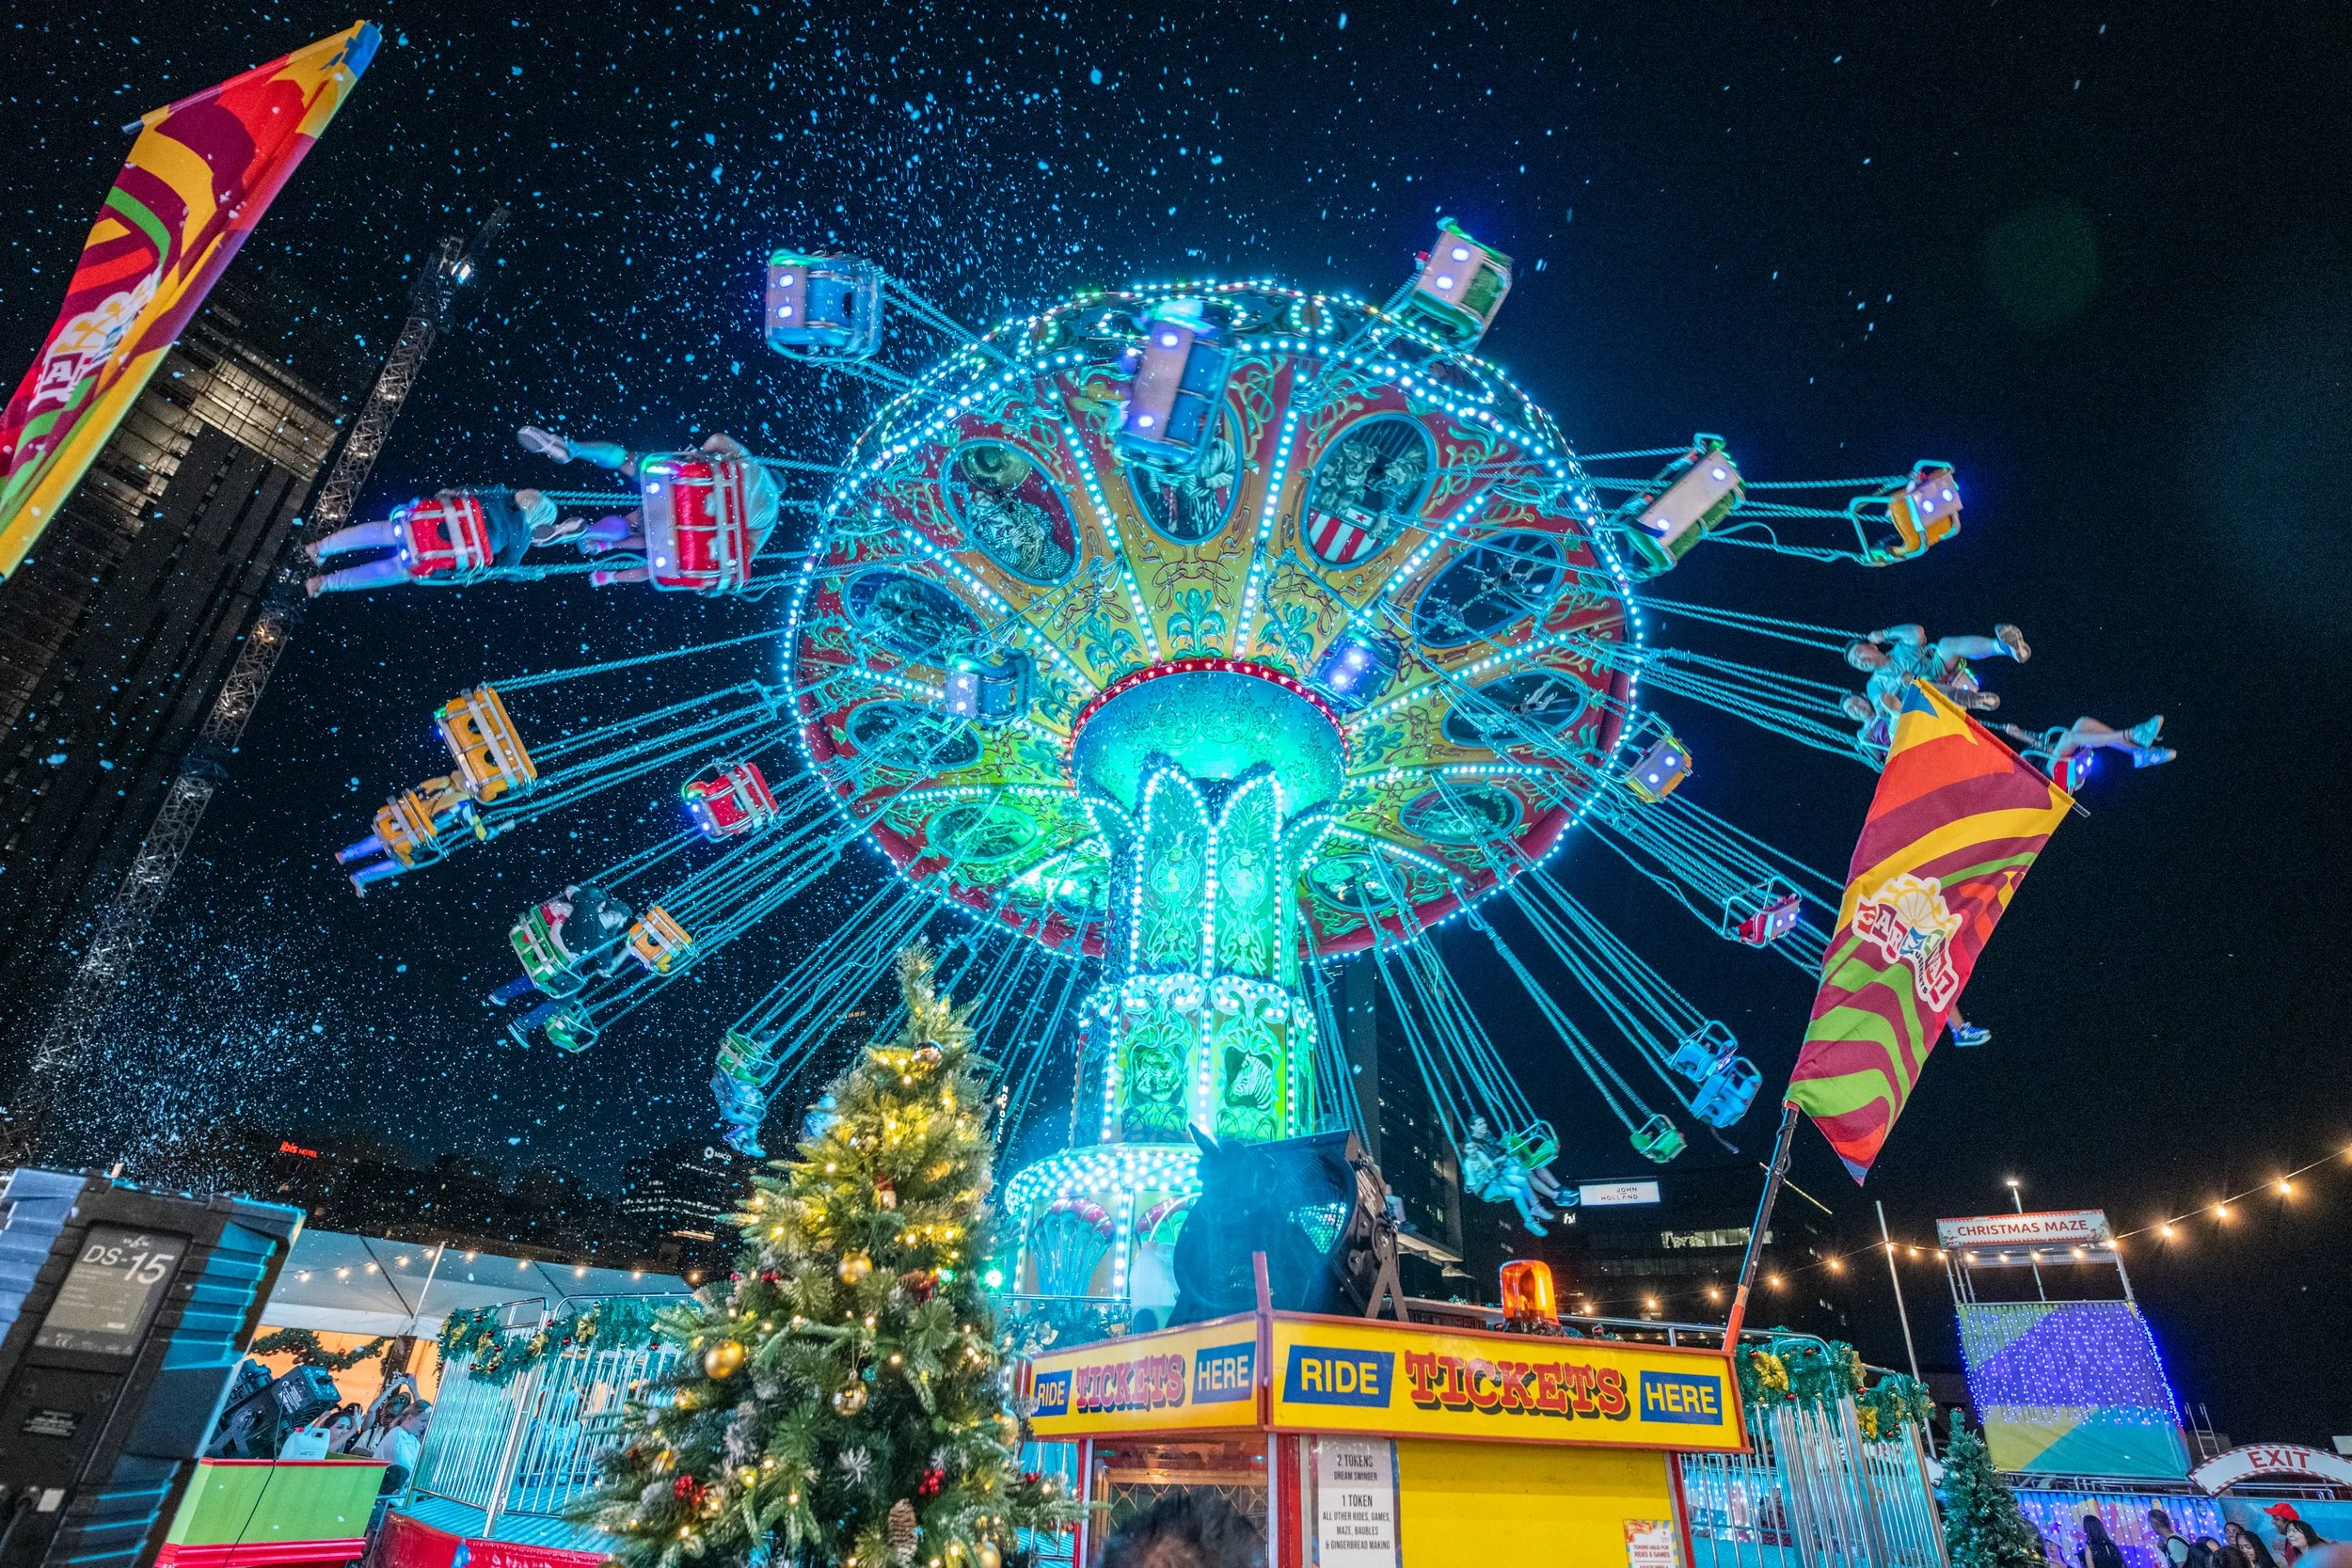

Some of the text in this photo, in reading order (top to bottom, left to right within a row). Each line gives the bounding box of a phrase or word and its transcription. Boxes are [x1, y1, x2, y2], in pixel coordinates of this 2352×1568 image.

[1857, 901, 1955, 1005] CARNIVAL
[997, 1085, 1009, 1144] NOVOTEL
[279, 1140, 317, 1158] ibis HOTEL
[1957, 1219, 2089, 1236] CHRISTMAS MAZE
[82, 1244, 175, 1285] DS-15
[1038, 1353, 1250, 1414] RIDE TICKETS HERE
[1300, 1349, 1719, 1422] RIDE TICKETS HERE
[1337, 1454, 1374, 1467] 2 TOKENS
[2247, 1449, 2311, 1469] EXIT
[1334, 1471, 1353, 1481] DREAM
[1342, 1494, 1373, 1507] 1 TOKEN
[1323, 1512, 1391, 1523] ALL OTHER RIDES, GAMES,
[1336, 1526, 1379, 1536] MAZE, BAUBLES
[1330, 1540, 1368, 1550] GINGERBREAD
[1369, 1541, 1391, 1550] MAKING
